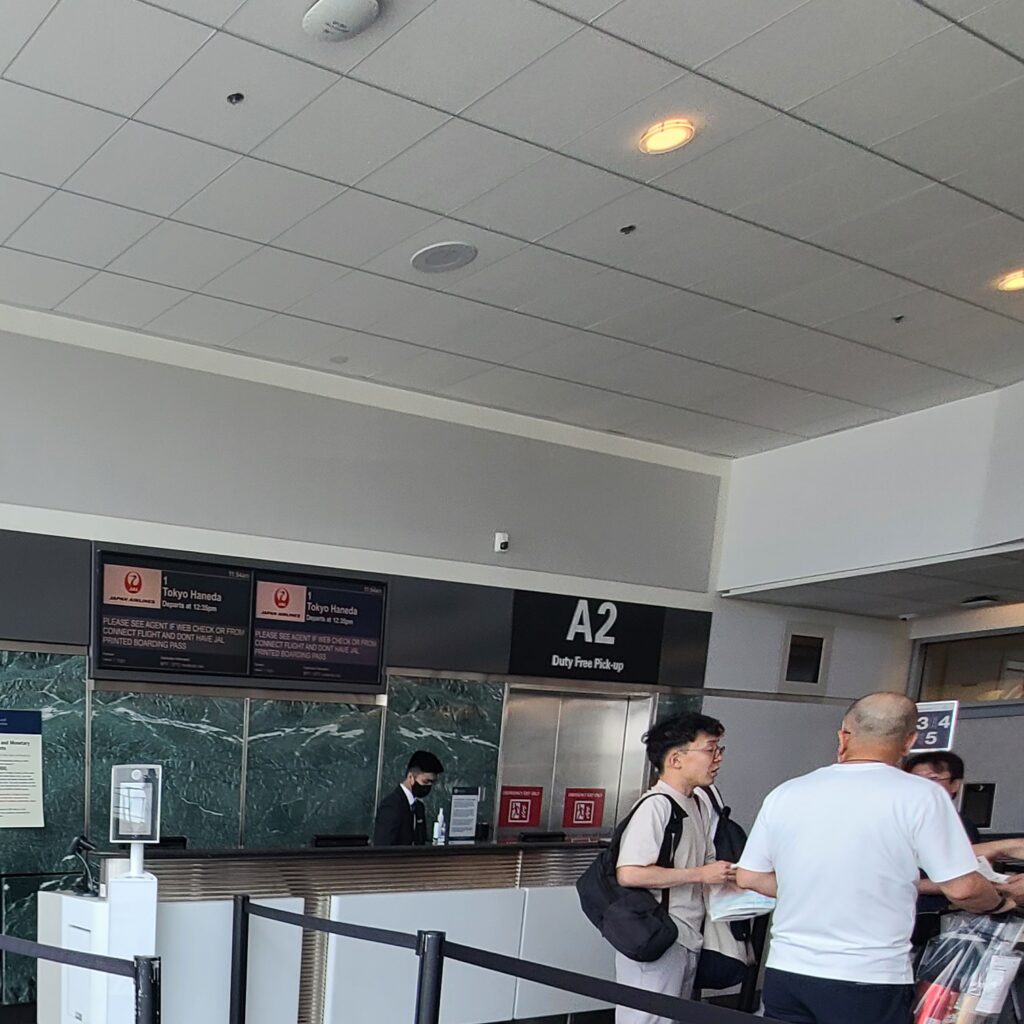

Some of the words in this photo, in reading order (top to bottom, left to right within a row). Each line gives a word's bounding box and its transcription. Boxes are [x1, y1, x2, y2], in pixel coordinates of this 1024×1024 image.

[163, 587, 189, 600] Tokyo
[190, 590, 222, 602] Haneda
[307, 602, 329, 614] Tokyo
[330, 604, 358, 616] Haneda
[103, 617, 130, 627] PLEASE
[130, 620, 145, 628] SEE
[146, 621, 168, 630] AGENT
[192, 625, 215, 634] CHECK
[216, 626, 226, 634] OR
[566, 599, 618, 645] A2
[103, 627, 136, 637] CONNECT
[137, 630, 161, 638] FLIGHT
[162, 632, 176, 640] AND
[256, 630, 278, 640] PLEASE
[291, 634, 311, 642] AGENT
[103, 636, 132, 646] PRINTED
[134, 638, 169, 648] BOARDING
[170, 641, 187, 650] PASS
[551, 654, 574, 670] Duty
[574, 656, 593, 668] Free
[594, 658, 624, 673] Pick-up
[916, 716, 929, 730] 3
[938, 714, 950, 729] 4
[924, 731, 938, 745] 5
